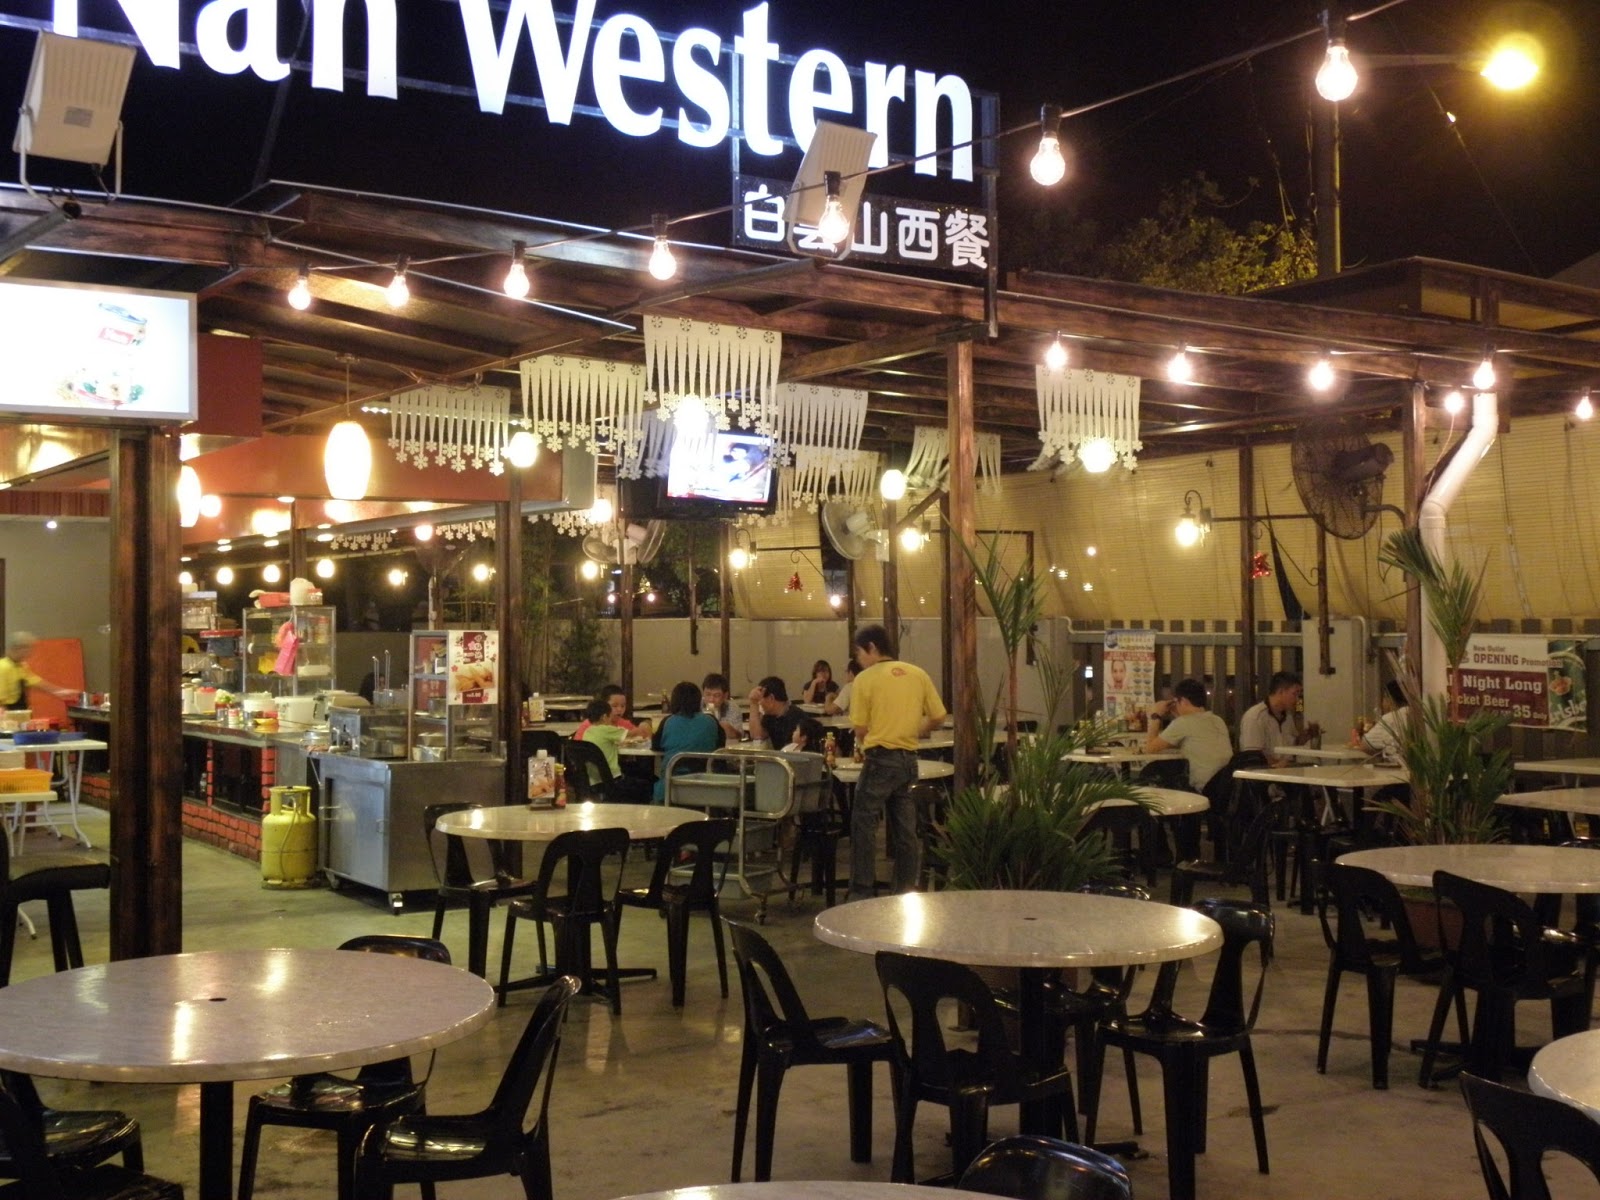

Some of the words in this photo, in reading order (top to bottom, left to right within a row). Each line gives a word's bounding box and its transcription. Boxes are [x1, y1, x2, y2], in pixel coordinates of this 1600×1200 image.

[458, 0, 974, 182] Western
[1473, 653, 1519, 665] OPENING
[1521, 658, 1562, 668] Promotion
[1462, 675, 1500, 691] Night
[1505, 677, 1542, 694] Long
[1445, 694, 1480, 705] Bcket
[1483, 695, 1510, 708] Beer
[1512, 705, 1531, 719] 35
